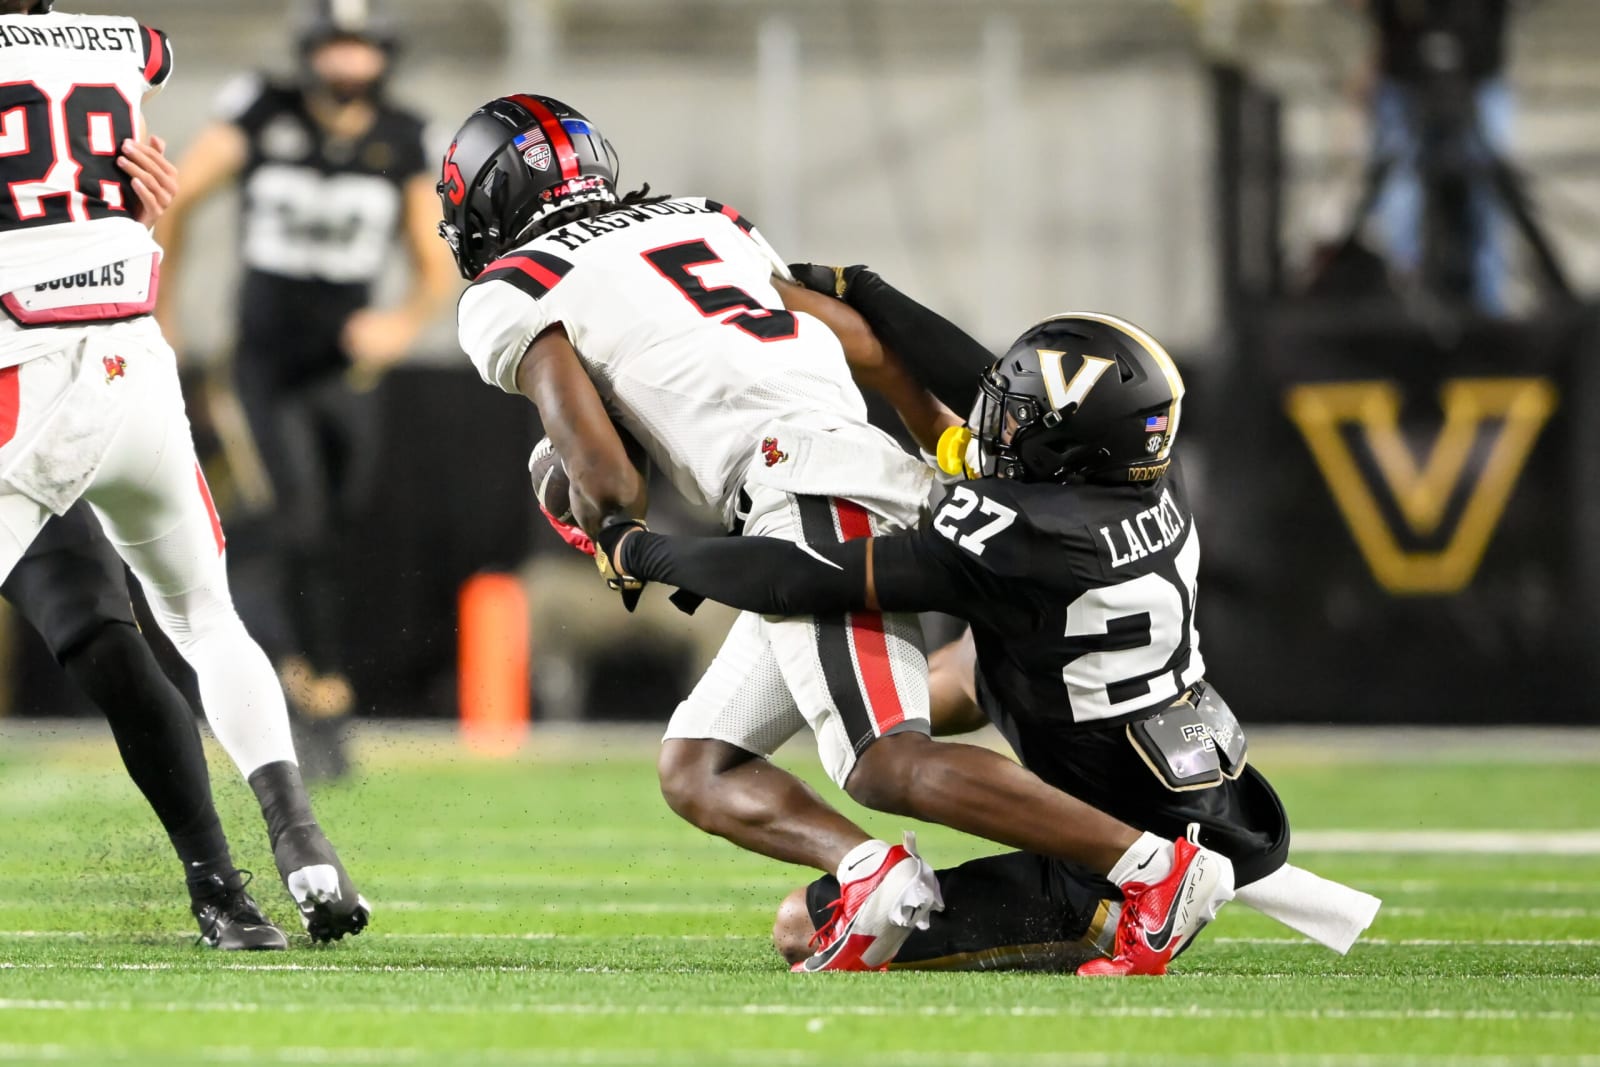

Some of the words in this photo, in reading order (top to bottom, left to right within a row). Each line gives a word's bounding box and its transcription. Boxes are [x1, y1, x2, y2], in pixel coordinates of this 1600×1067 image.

[0, 80, 134, 231] 28
[640, 238, 799, 343] 5
[1036, 349, 1115, 414] V
[933, 486, 1017, 556] 27
[1284, 376, 1557, 595] V
